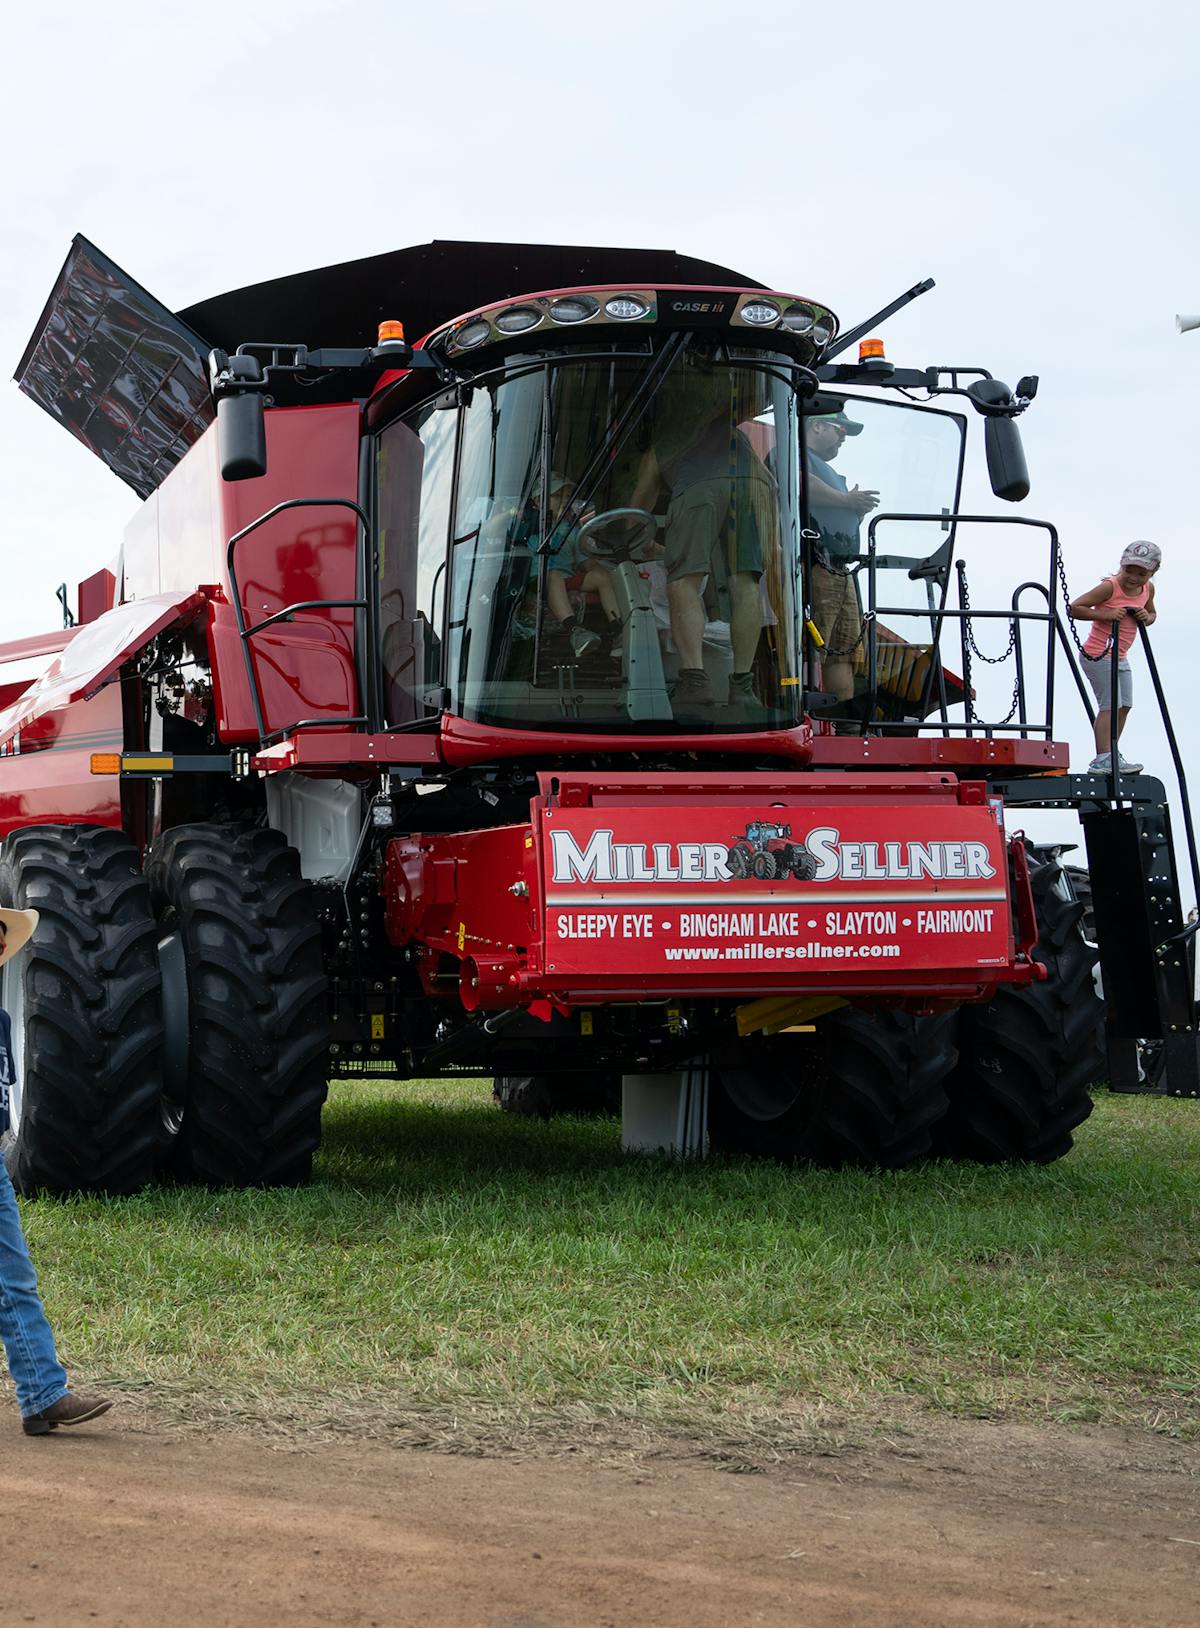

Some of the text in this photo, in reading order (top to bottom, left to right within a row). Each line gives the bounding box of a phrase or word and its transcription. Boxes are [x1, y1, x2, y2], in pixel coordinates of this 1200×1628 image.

[672, 302, 710, 312] CASE
[550, 826, 997, 883] MILLER SELLNER
[557, 909, 993, 939] SLEEPY EYE BINGHAM LAKE SLAYTON FAIRMONT
[664, 942, 900, 961] www.millersellner.com
